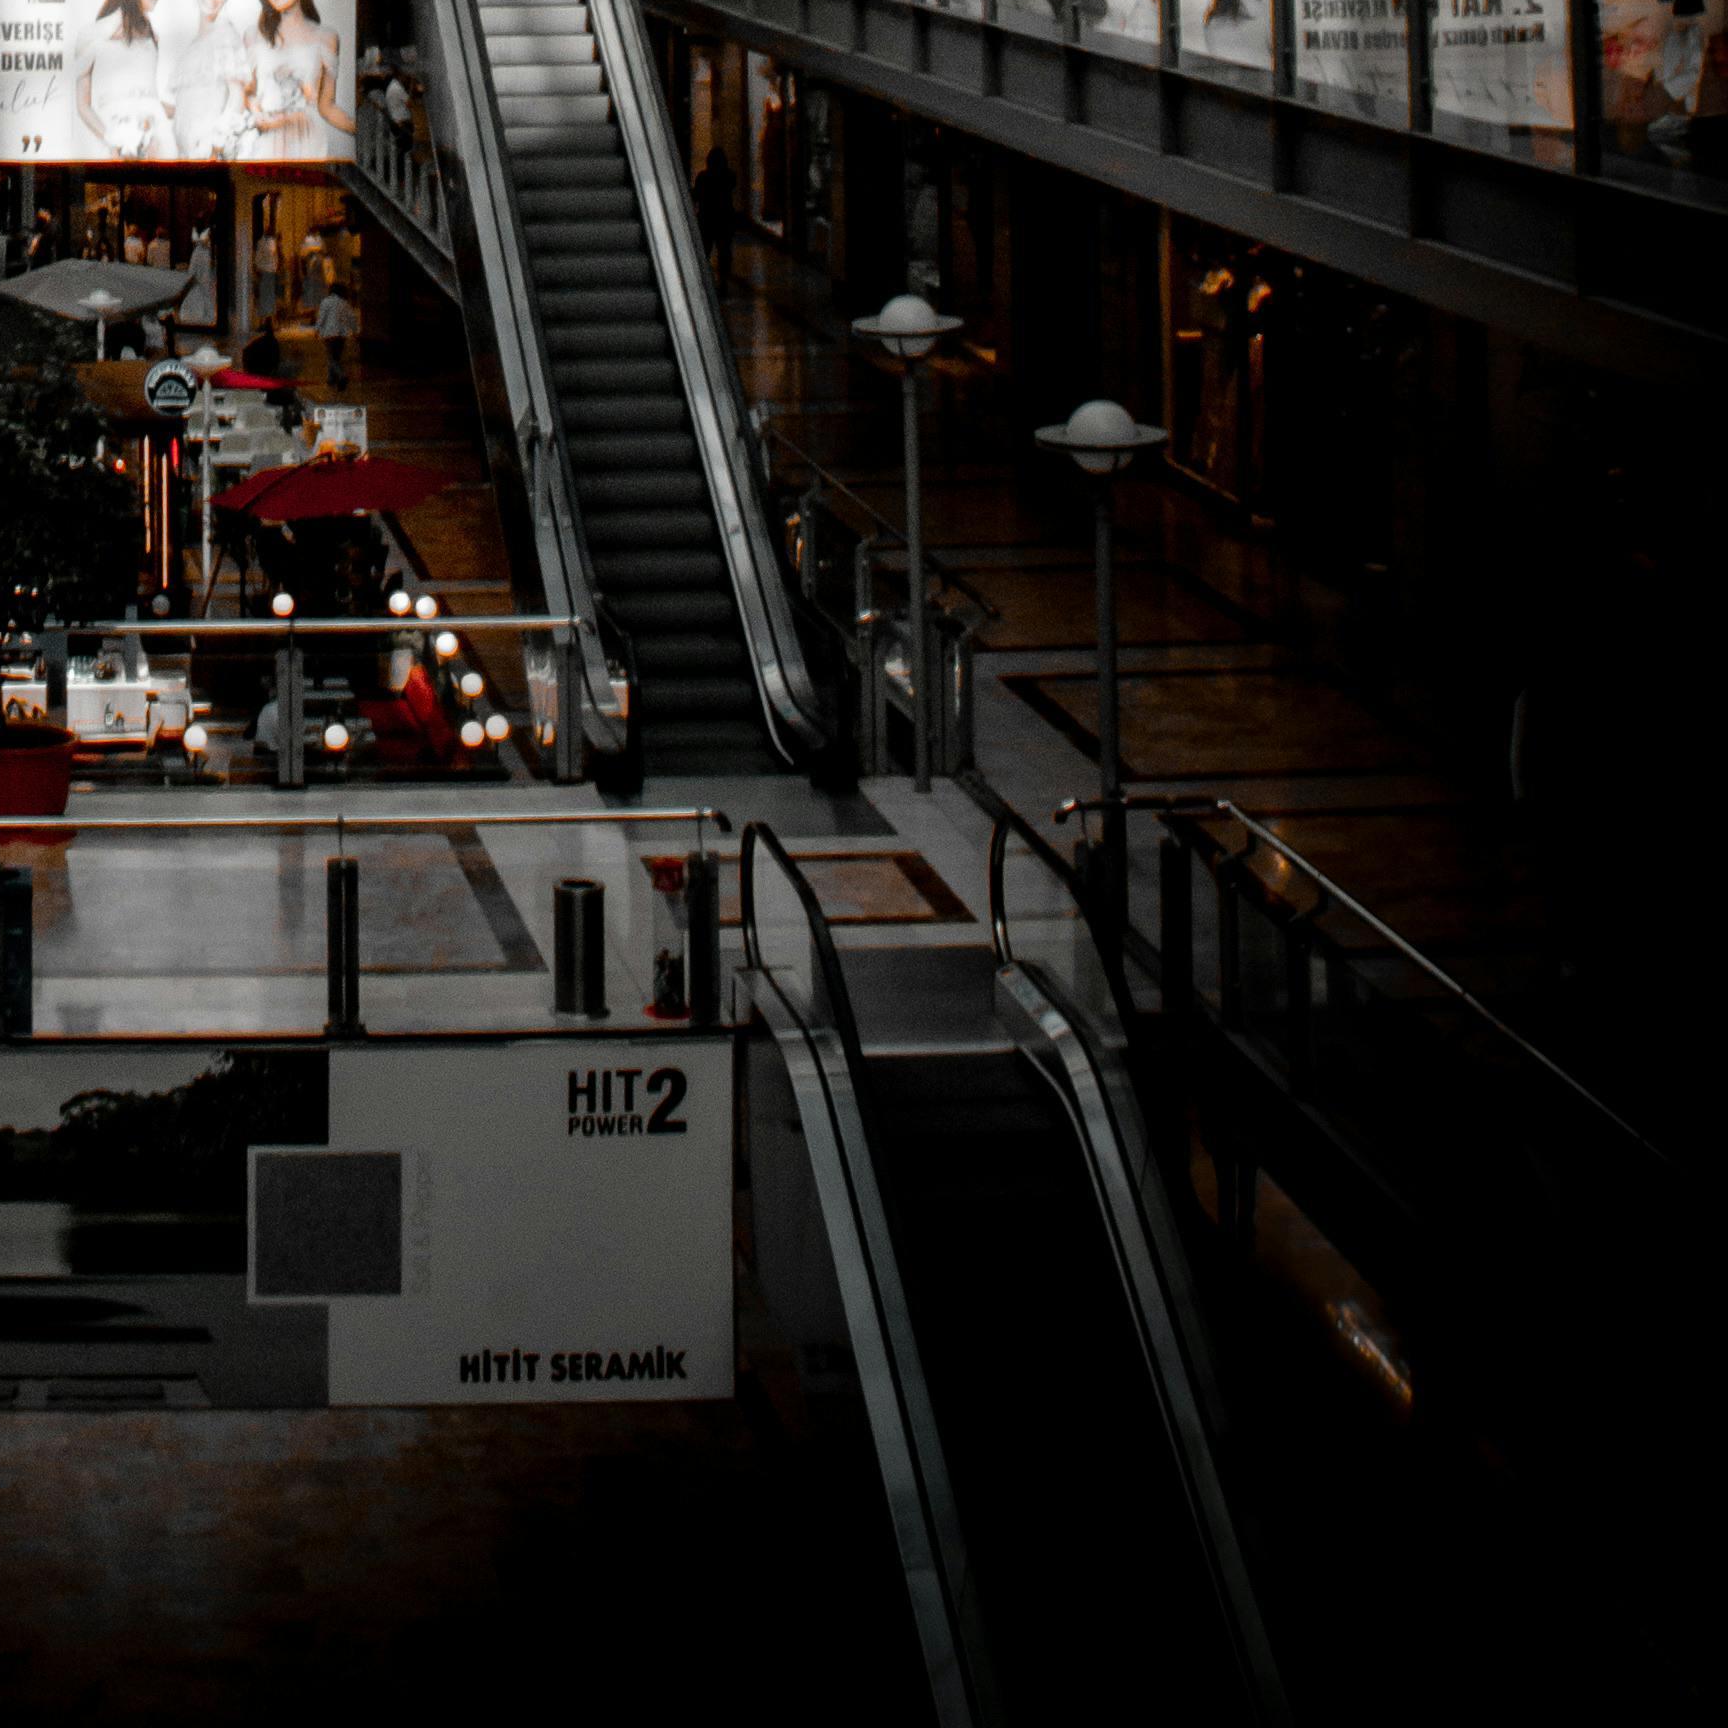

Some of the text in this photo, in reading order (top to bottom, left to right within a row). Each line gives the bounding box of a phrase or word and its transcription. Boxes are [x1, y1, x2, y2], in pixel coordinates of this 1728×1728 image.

[1, 50, 64, 72] DEVAM
[568, 1115, 643, 1137] POWER
[460, 1344, 687, 1383] HİTİT SERAMİK
